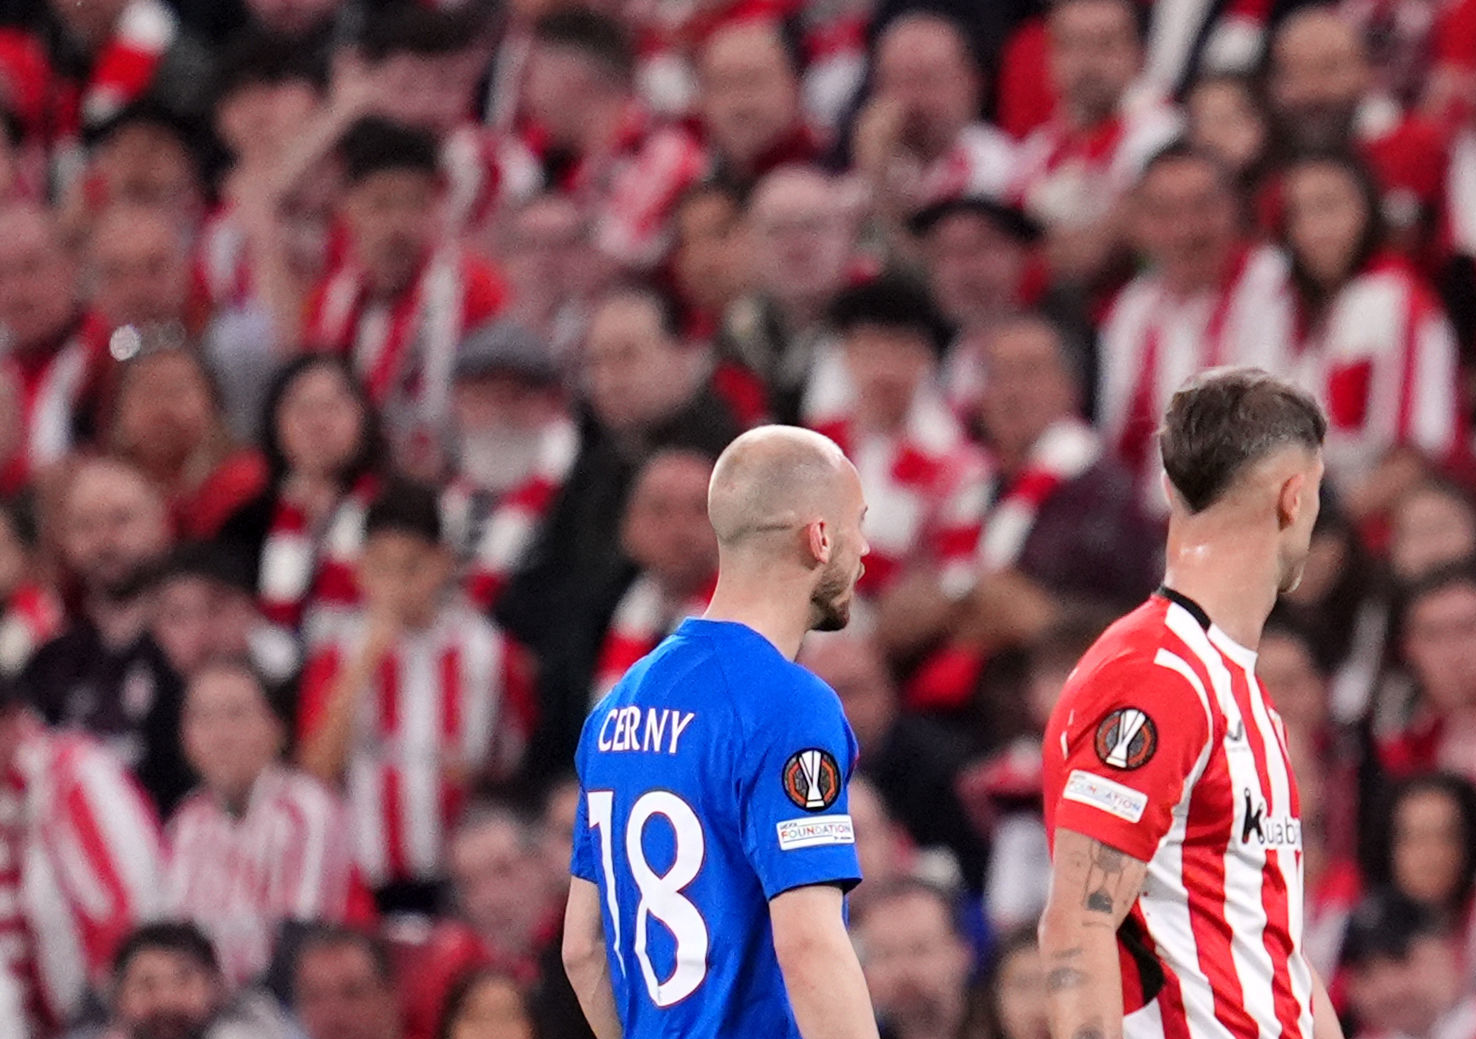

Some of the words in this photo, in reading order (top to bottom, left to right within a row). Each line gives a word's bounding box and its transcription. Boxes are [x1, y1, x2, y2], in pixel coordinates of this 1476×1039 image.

[598, 705, 695, 754] CERNY
[781, 823, 852, 839] FOUNDATION
[586, 789, 710, 1008] 18
